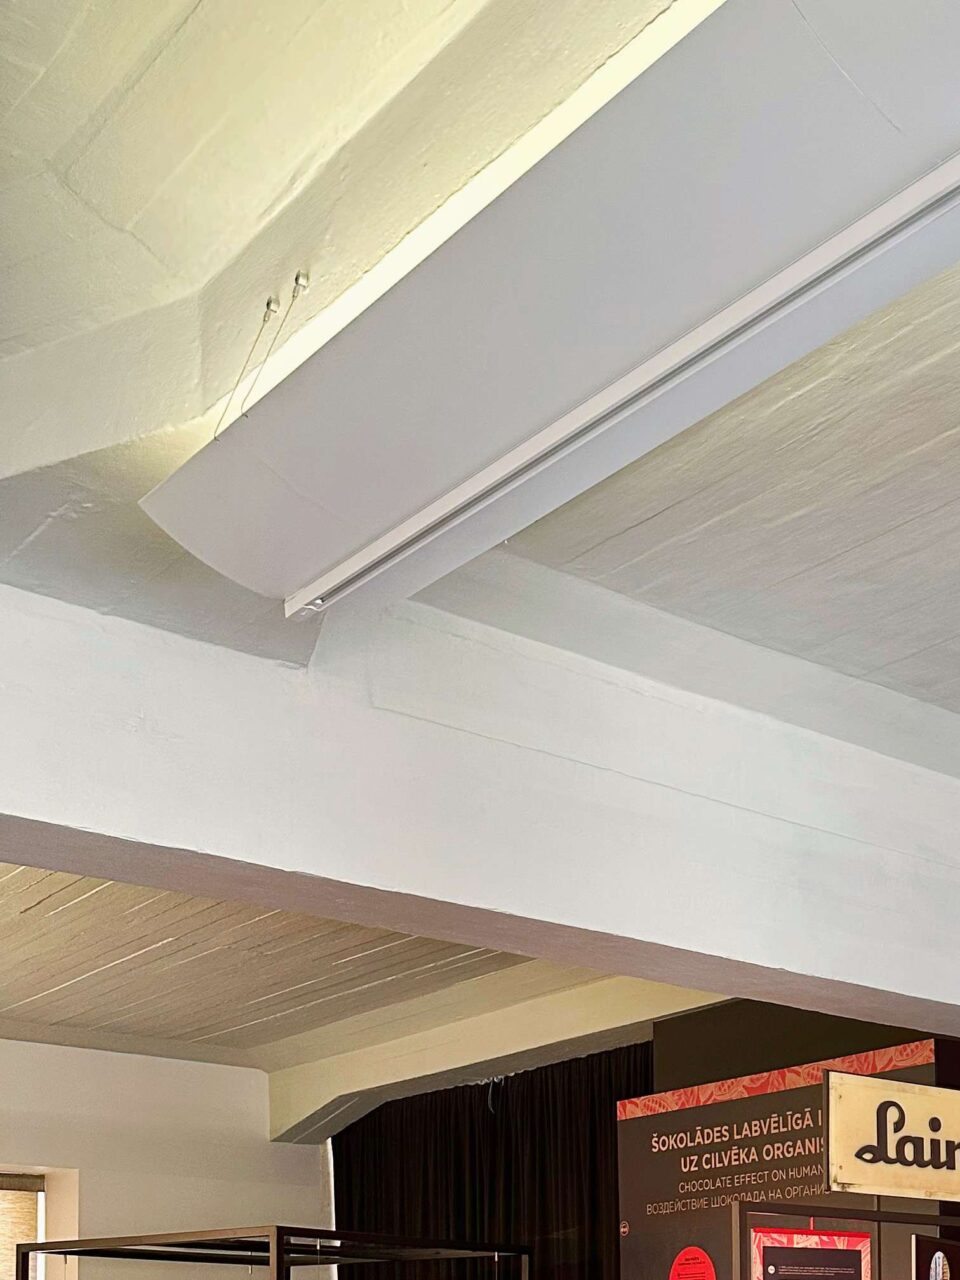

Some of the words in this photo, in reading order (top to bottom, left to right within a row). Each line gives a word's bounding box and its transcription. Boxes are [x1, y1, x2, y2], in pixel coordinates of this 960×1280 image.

[651, 1125, 730, 1152] ŠOKOLĀDES
[733, 1108, 813, 1139] LABVĒLĪGĀ
[681, 1156, 699, 1172] UZ
[702, 1146, 759, 1169] CILVĒKA
[678, 1176, 732, 1193] CHOCOLATE
[734, 1171, 769, 1187] EFFECT
[771, 1169, 786, 1182] ON
[646, 1198, 709, 1215] ВОЗДЕЙСТВИЕ
[768, 1188, 783, 1200] НА
[785, 1182, 830, 1200] ОРГАНИ
